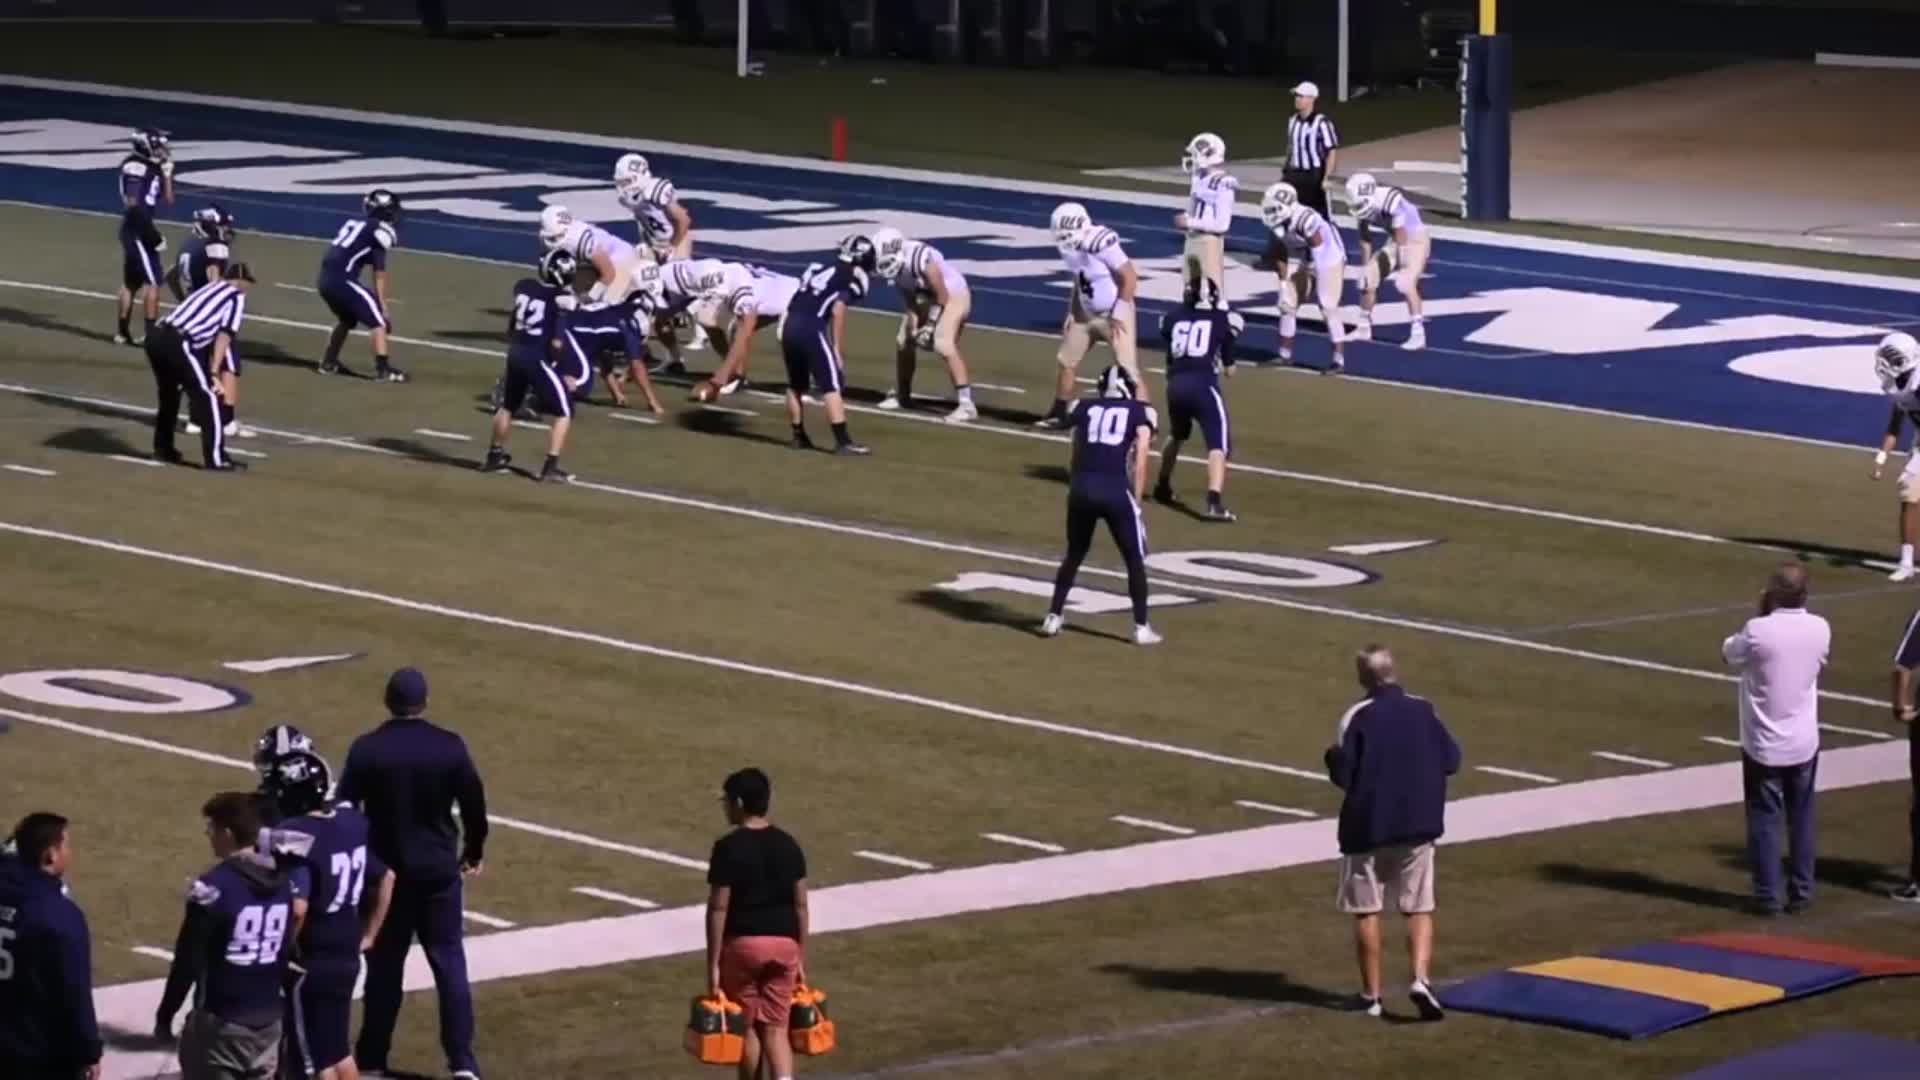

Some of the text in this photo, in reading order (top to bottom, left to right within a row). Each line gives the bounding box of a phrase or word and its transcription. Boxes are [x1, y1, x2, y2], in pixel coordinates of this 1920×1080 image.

[1171, 320, 1212, 358] 60
[1087, 405, 1129, 446] 10
[327, 845, 366, 913] 77
